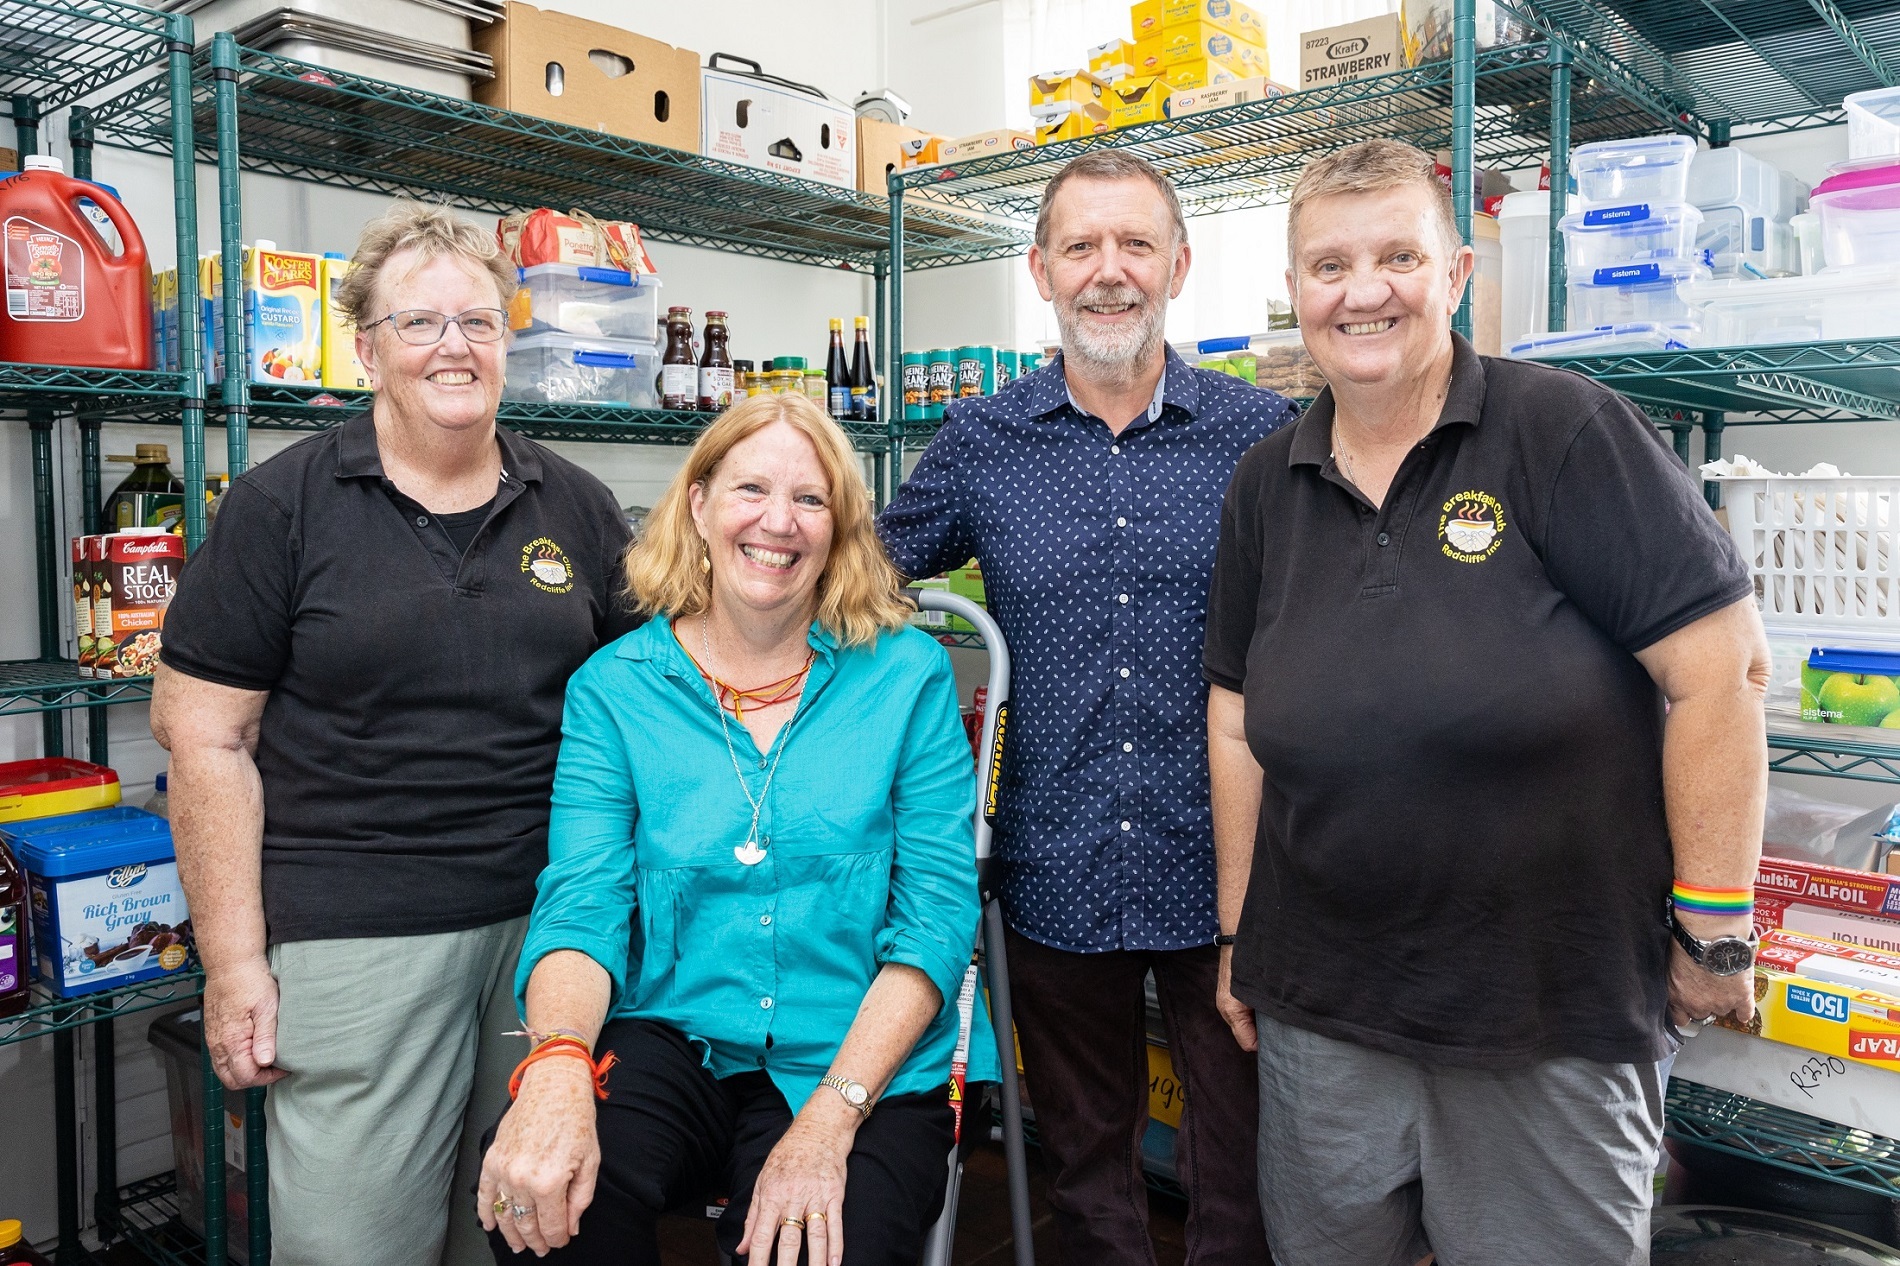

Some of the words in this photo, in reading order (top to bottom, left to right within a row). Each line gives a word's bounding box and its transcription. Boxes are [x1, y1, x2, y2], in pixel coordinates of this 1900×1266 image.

[1306, 37, 1329, 49] 87223
[1335, 42, 1359, 56] Kraft
[1305, 53, 1391, 82] STRAWBERRY
[1200, 90, 1228, 99] RASPBERRY
[1602, 211, 1630, 220] sistema
[263, 254, 312, 271] FOSTER
[263, 269, 313, 288] CLARKS
[1612, 269, 1640, 278] sistema
[261, 313, 301, 324] CUSTARD
[960, 362, 976, 371] EINZ
[1443, 490, 1496, 513] Breakfast
[1494, 503, 1507, 532] Club
[122, 541, 168, 555] Campbell's
[1442, 544, 1486, 563] Redcliffe
[123, 565, 175, 585] REAL
[520, 555, 530, 573] The
[562, 556, 574, 578] Club
[123, 583, 176, 600] STOCK
[530, 578, 566, 594] Redcliffe
[121, 618, 153, 627] Chicken
[1803, 707, 1842, 719] sistema
[107, 862, 148, 889] Edlyn
[1810, 875, 1849, 887] AUSTRALIA'S
[1849, 882, 1885, 893] STRONGEST
[1807, 883, 1868, 905] ALFOIL
[83, 903, 118, 919] Rich
[122, 893, 171, 912] Brown
[106, 911, 152, 932] Gravy
[1810, 993, 1845, 1019] 150
[1790, 1056, 1846, 1098] R230
